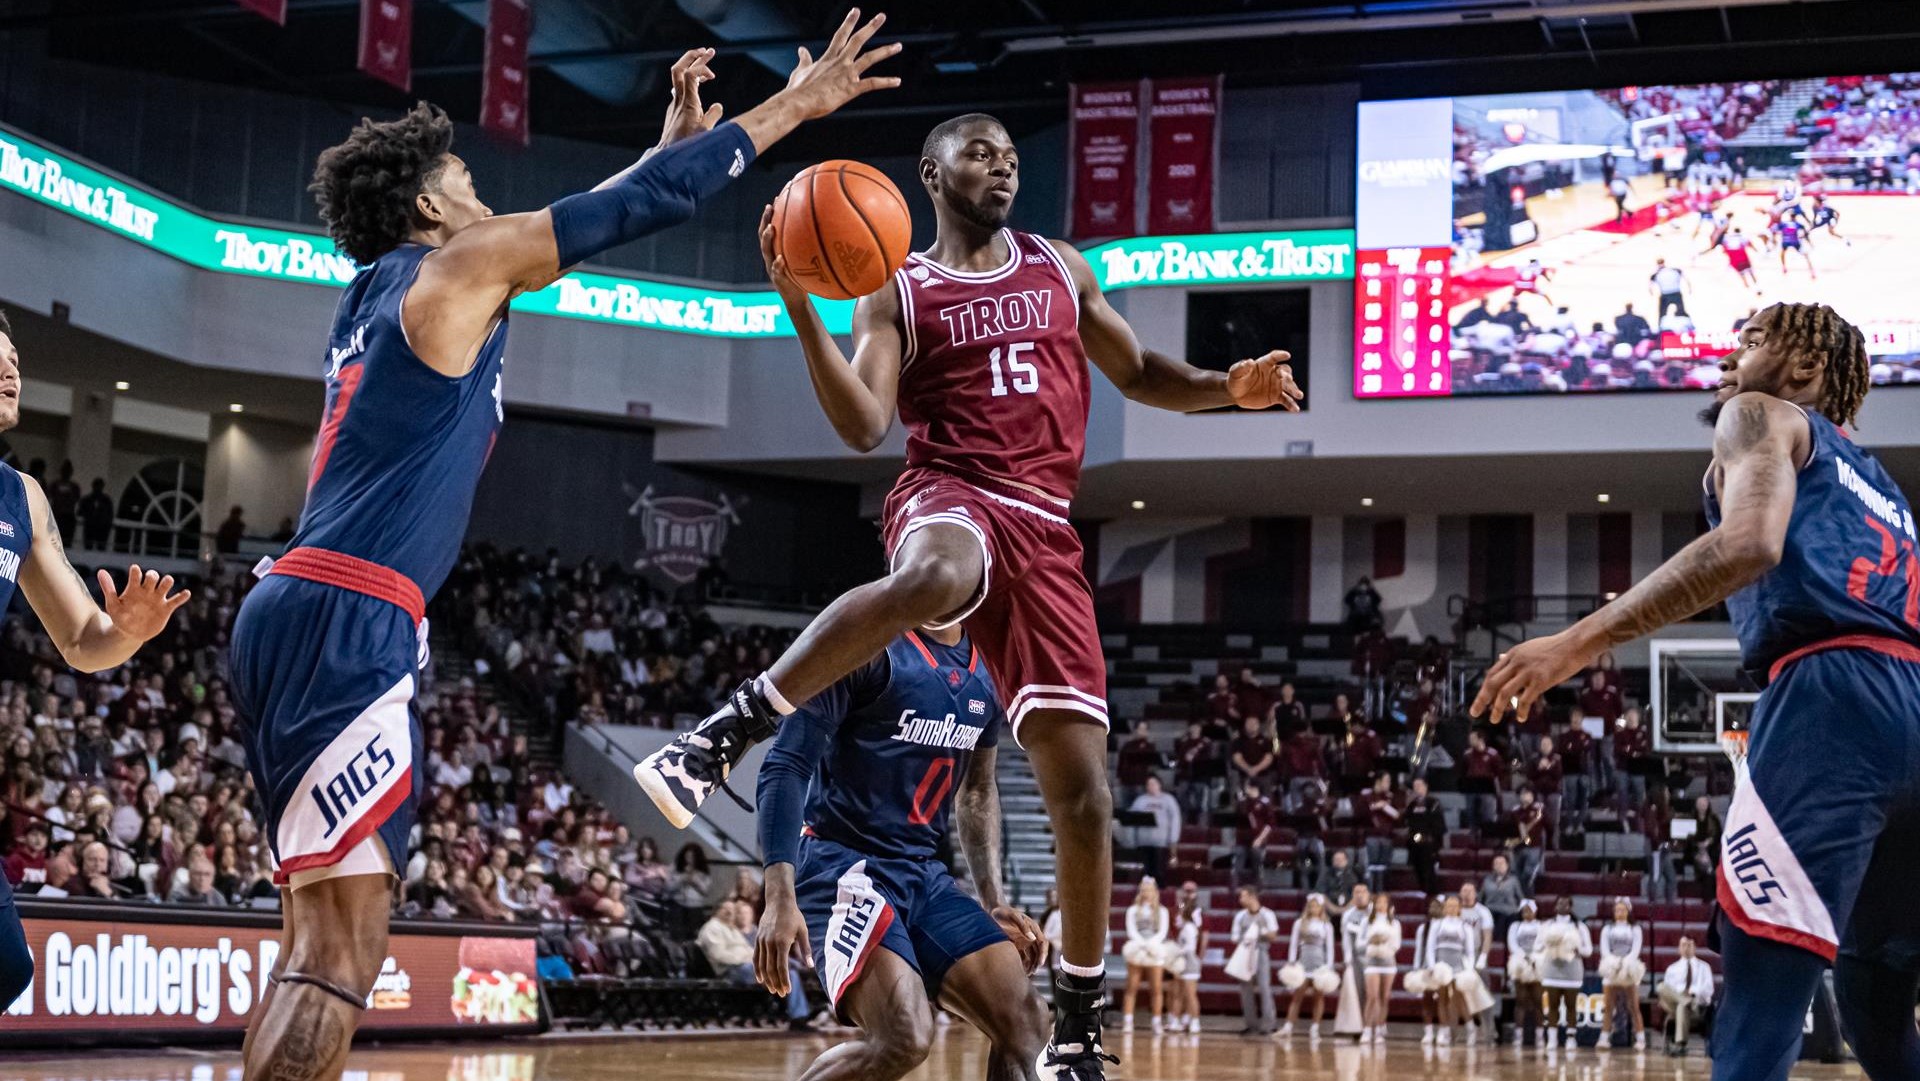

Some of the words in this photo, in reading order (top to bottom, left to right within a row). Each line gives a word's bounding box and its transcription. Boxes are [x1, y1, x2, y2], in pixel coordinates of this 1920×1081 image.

[1262, 239, 1350, 276] TRUST
[704, 297, 781, 333] TRUST
[940, 289, 1051, 346] TROY
[989, 341, 1039, 397] 15
[1835, 456, 1902, 528] MANNING
[311, 732, 395, 839] JAGS
[907, 757, 955, 825] 0
[1726, 823, 1789, 906] JAGS
[832, 893, 875, 967] JAGS
[46, 932, 252, 1024] Goldberg's
